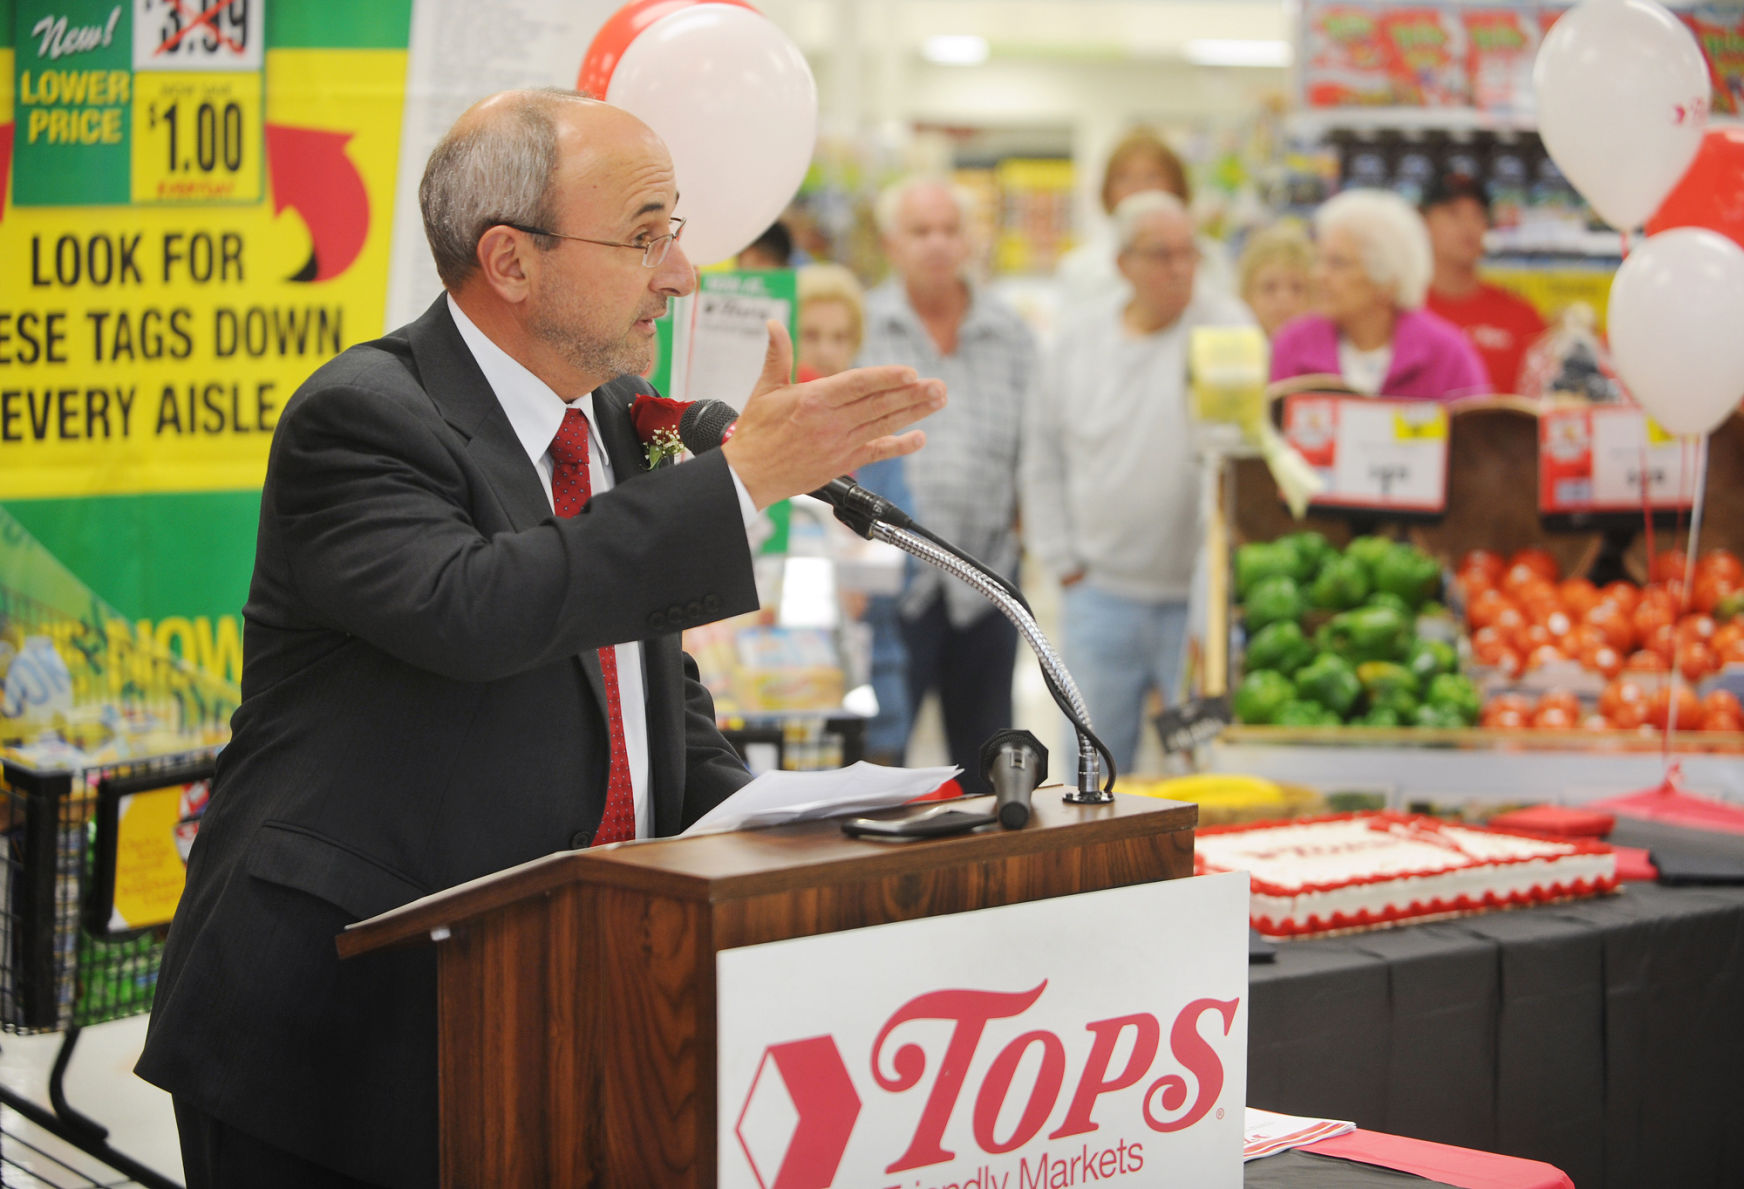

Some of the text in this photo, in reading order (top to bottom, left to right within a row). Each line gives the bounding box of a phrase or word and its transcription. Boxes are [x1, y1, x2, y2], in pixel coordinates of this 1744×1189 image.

[31, 5, 122, 59] New!
[21, 70, 130, 105] LOWER
[29, 109, 122, 144] PRICE
[149, 103, 242, 173] $1.00
[31, 232, 244, 287] LOOK FOR
[87, 309, 193, 362] TAGS
[215, 306, 342, 358] DOWN
[2, 383, 276, 441] EVERY AISLE
[1020, 1138, 1144, 1189] Markets
